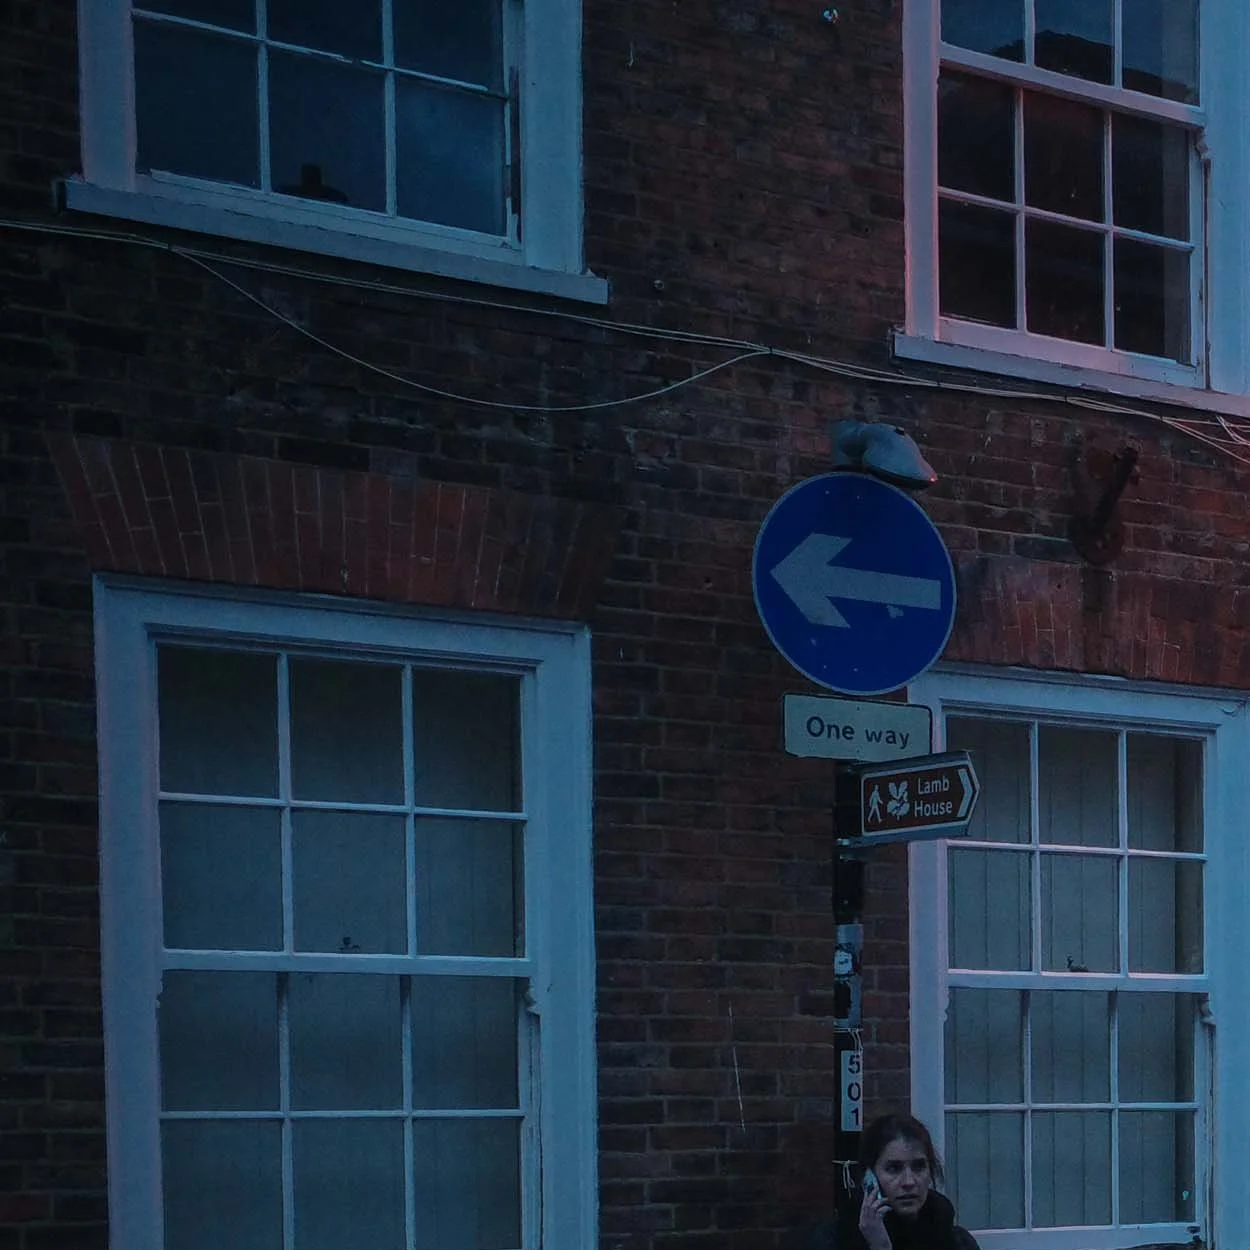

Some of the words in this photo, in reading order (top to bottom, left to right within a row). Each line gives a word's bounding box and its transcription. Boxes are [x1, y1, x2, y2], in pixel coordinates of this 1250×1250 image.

[806, 716, 855, 741] One
[865, 729, 910, 749] way
[917, 775, 950, 795] Lamb
[913, 799, 953, 818] House
